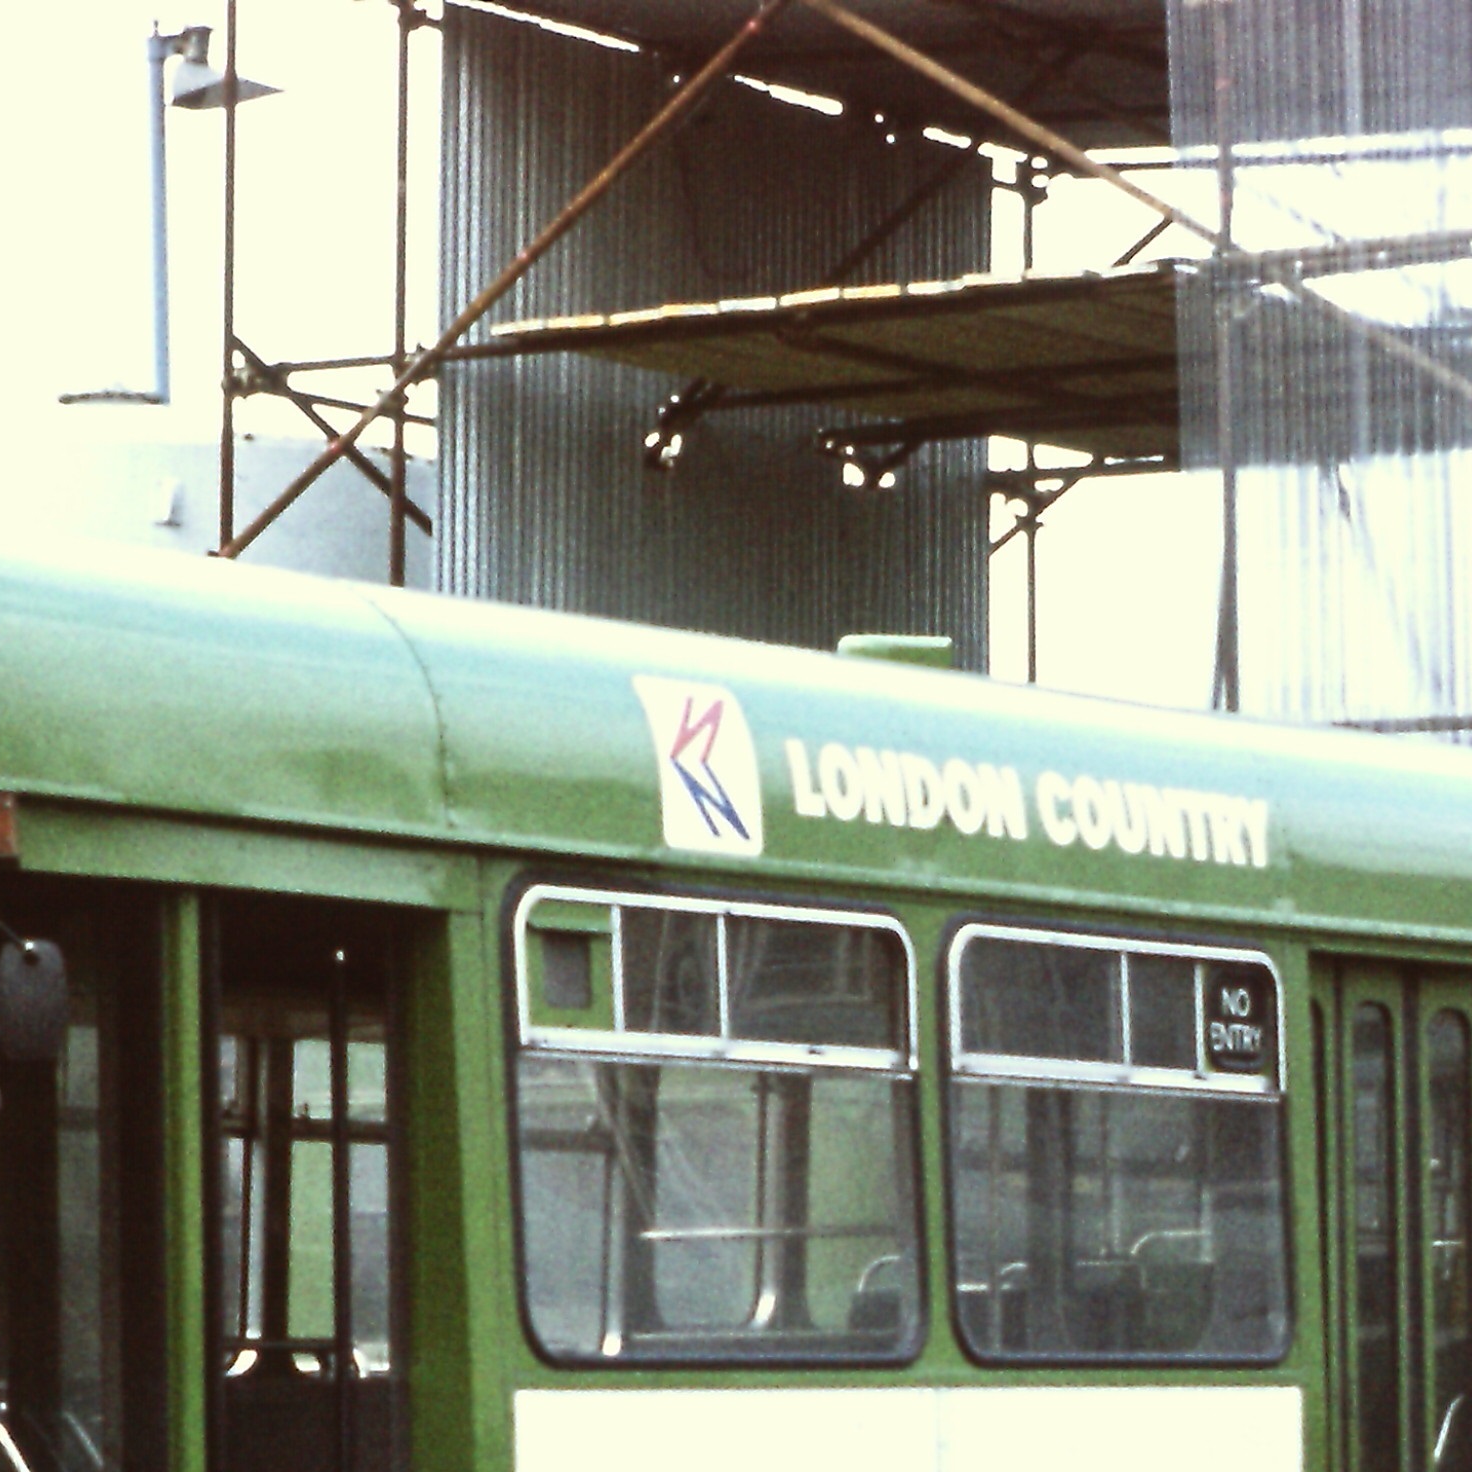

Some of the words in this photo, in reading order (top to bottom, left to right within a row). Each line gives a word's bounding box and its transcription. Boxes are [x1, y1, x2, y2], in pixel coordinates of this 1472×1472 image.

[786, 739, 1028, 840] LONDON
[1034, 771, 1268, 868] COUNTRY
[1221, 987, 1250, 1017] NO
